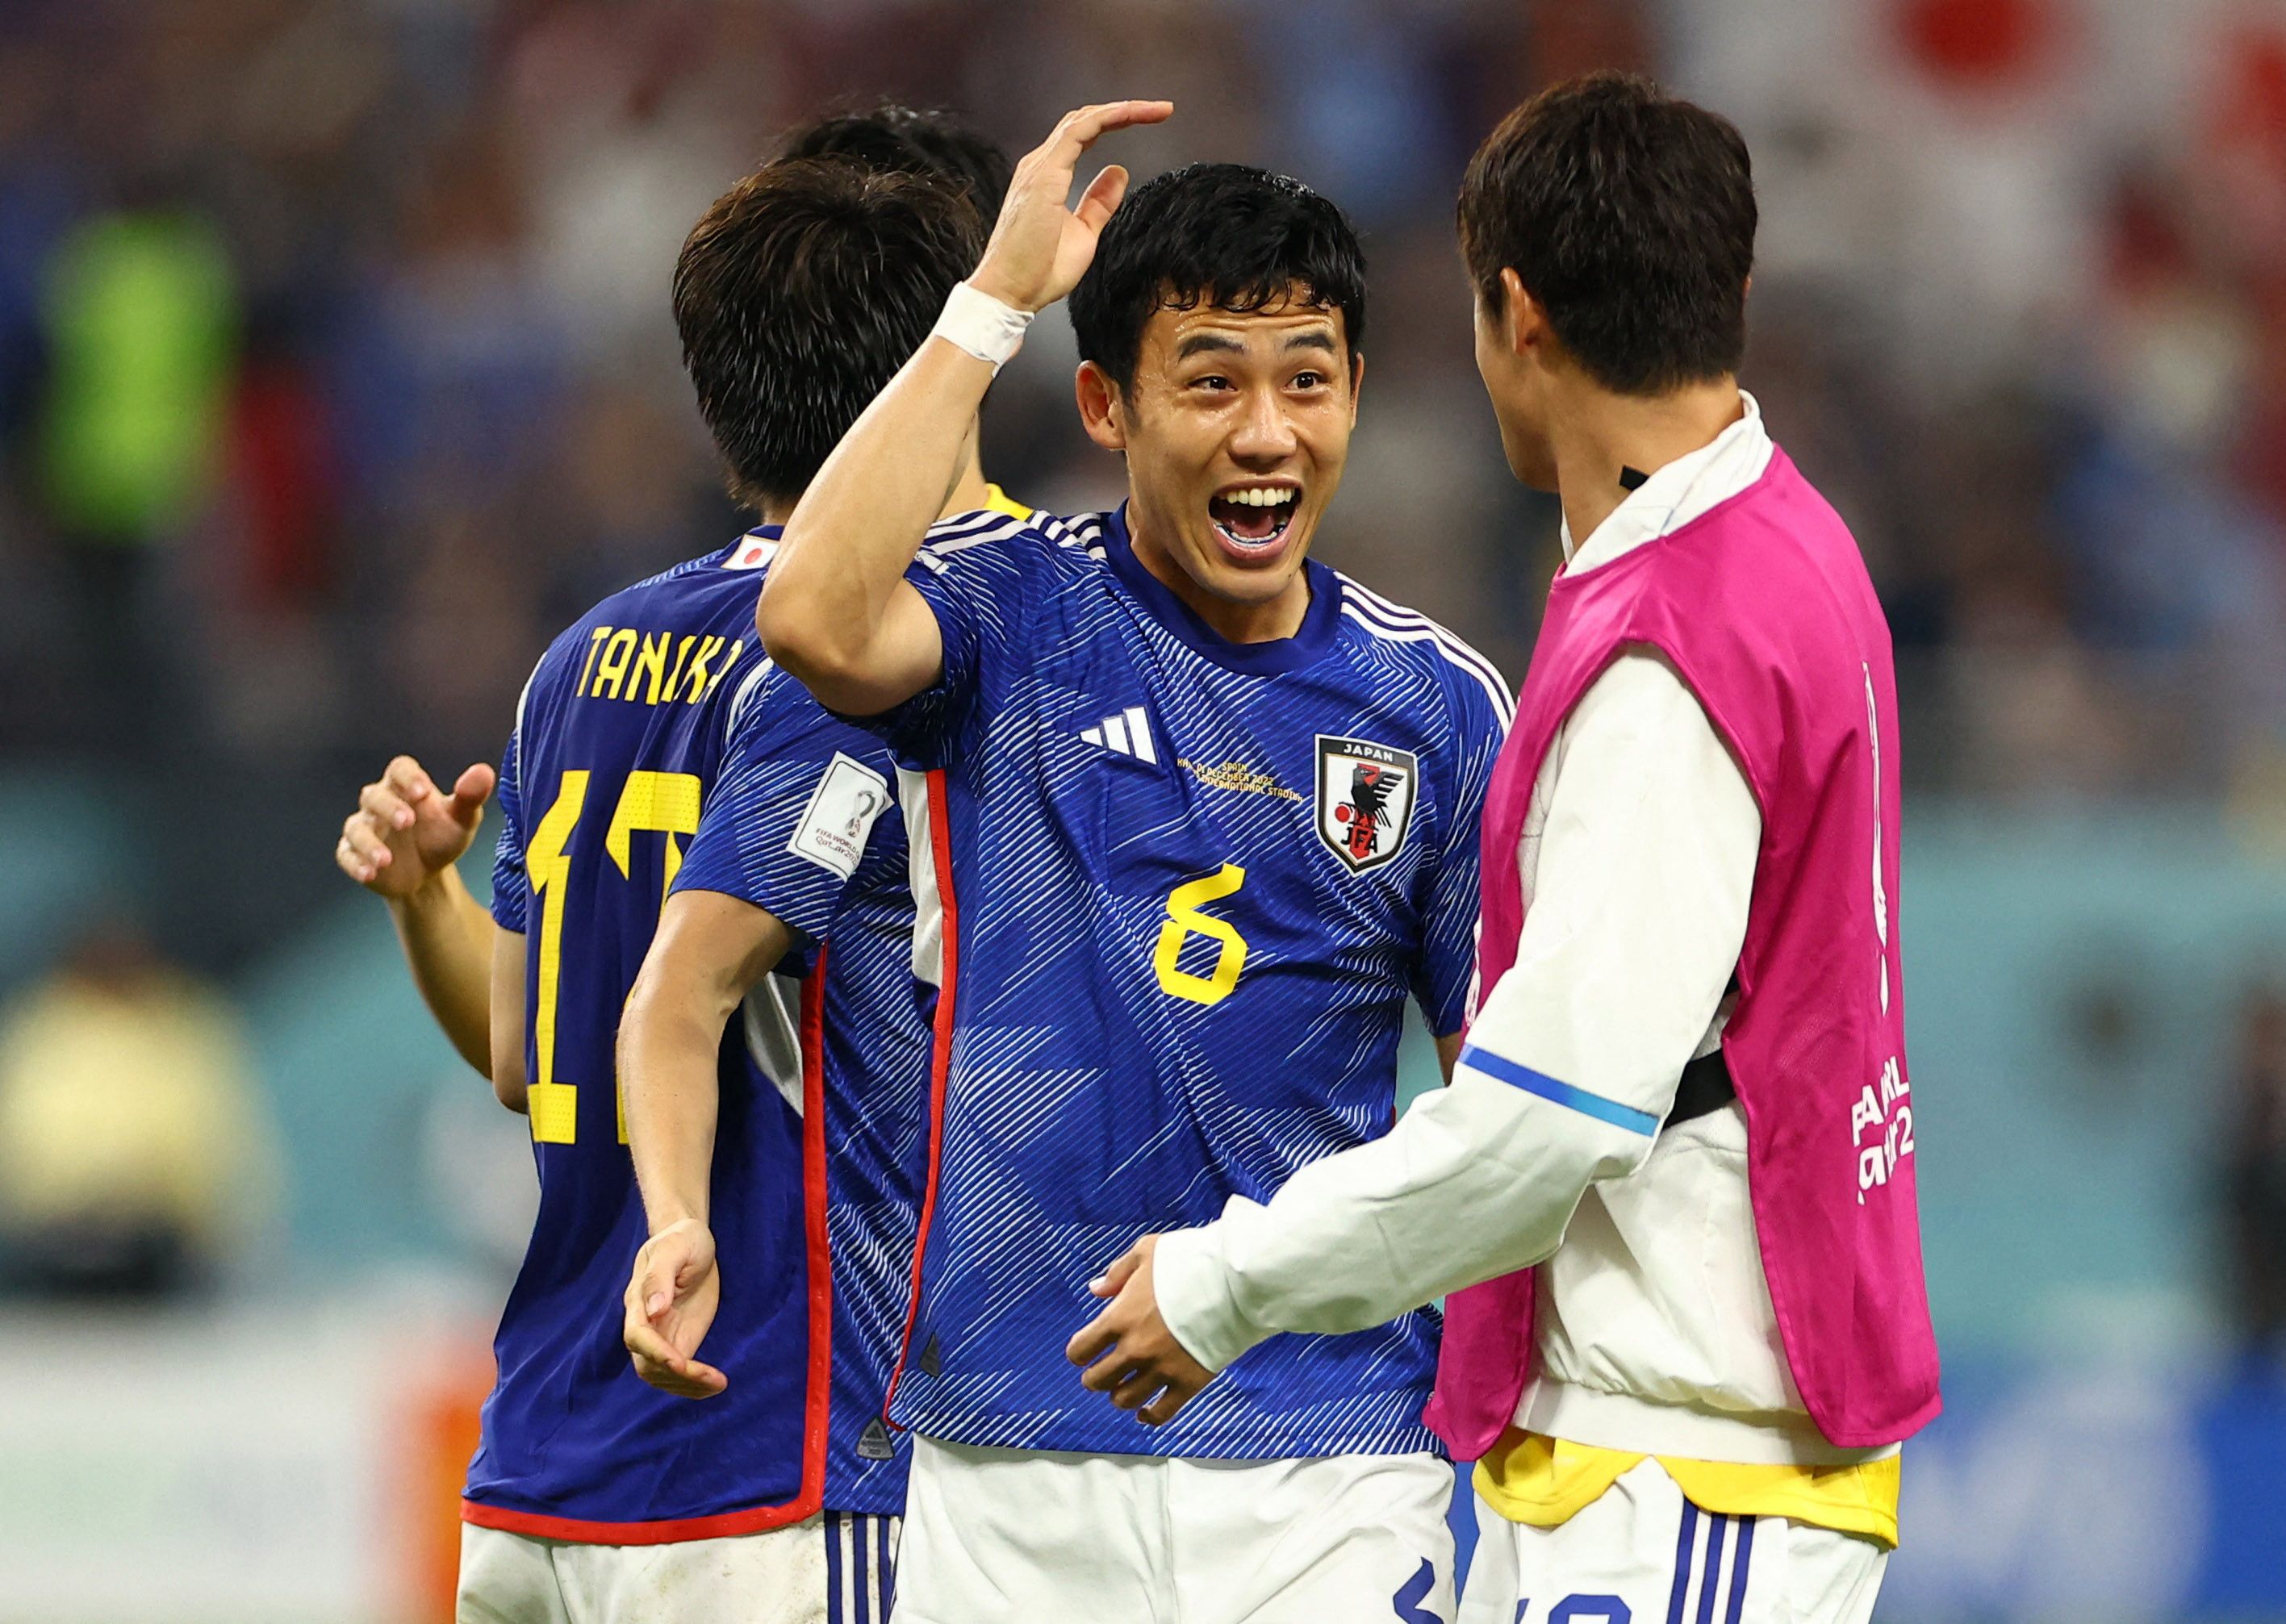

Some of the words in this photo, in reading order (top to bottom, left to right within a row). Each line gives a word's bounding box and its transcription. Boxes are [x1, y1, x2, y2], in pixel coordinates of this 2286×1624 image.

[1344, 744, 1393, 762] JAPAN
[1207, 767, 1250, 782] DECEMBER
[1252, 774, 1273, 786] 2022
[1222, 761, 1247, 772] SPAIN
[816, 828, 832, 839] FIFA
[833, 834, 856, 852] WORLD
[1340, 826, 1378, 854] JFA
[1154, 863, 1247, 1006] 6
